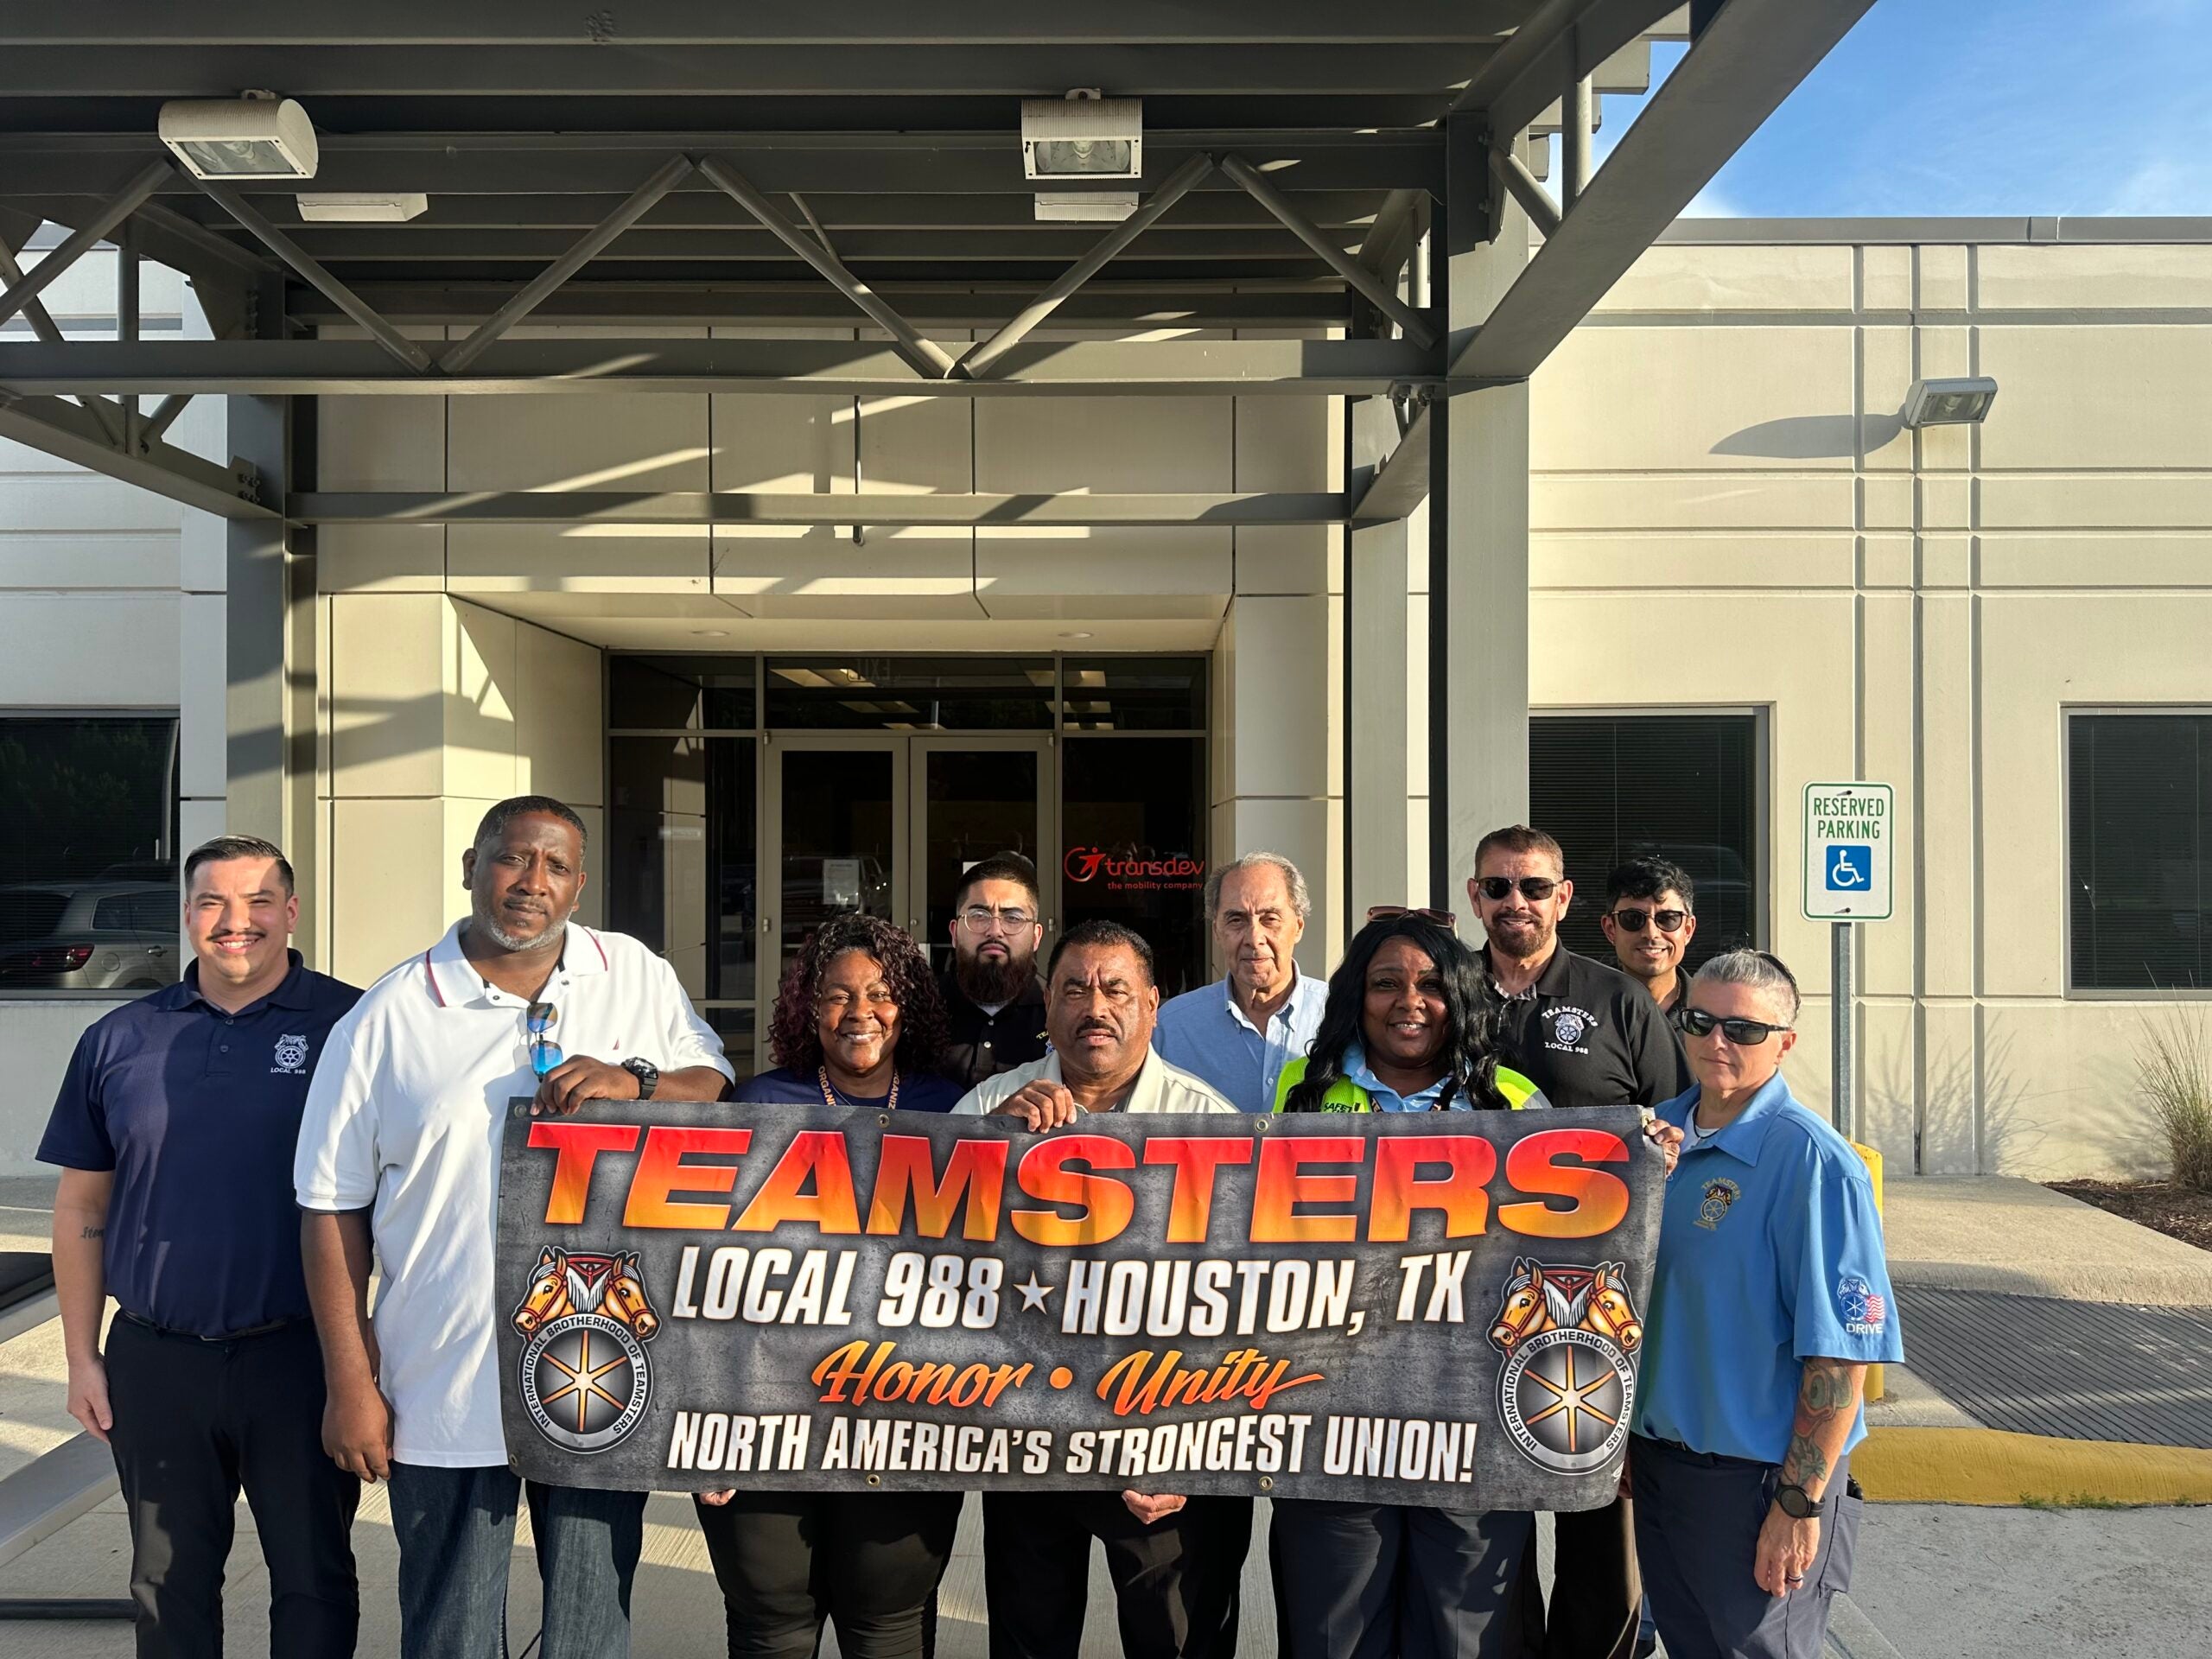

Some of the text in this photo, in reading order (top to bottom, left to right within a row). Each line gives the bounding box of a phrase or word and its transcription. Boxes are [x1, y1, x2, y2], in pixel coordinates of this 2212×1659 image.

[1814, 798, 1885, 817] RESERVED
[1818, 820, 1880, 840] PARKING
[1104, 856, 1205, 876] transdev
[1108, 881, 1203, 891] the mobility company
[1541, 1006, 1599, 1027] TEAMSTERS
[1544, 1041, 1589, 1055] LOCAL 988
[818, 1065, 836, 1106] ORGANI
[527, 1121, 1630, 1247] TEAMSTERS
[671, 1246, 1472, 1338] LOCAL 988 HOUSTON, TX
[1846, 1323, 1884, 1335] DRIVE
[524, 1315, 646, 1435] INTERNATIONAL BROTHERHOOD OF TEAMSTERS
[810, 1340, 1033, 1408] Honor
[1096, 1348, 1325, 1417] Unity
[1503, 1331, 1633, 1452] INTERNATIONAL BROTHERHOOD OF TEAMSTERS
[667, 1411, 1478, 1484] NORTH AMERICA'S STRONGEST UNION!
